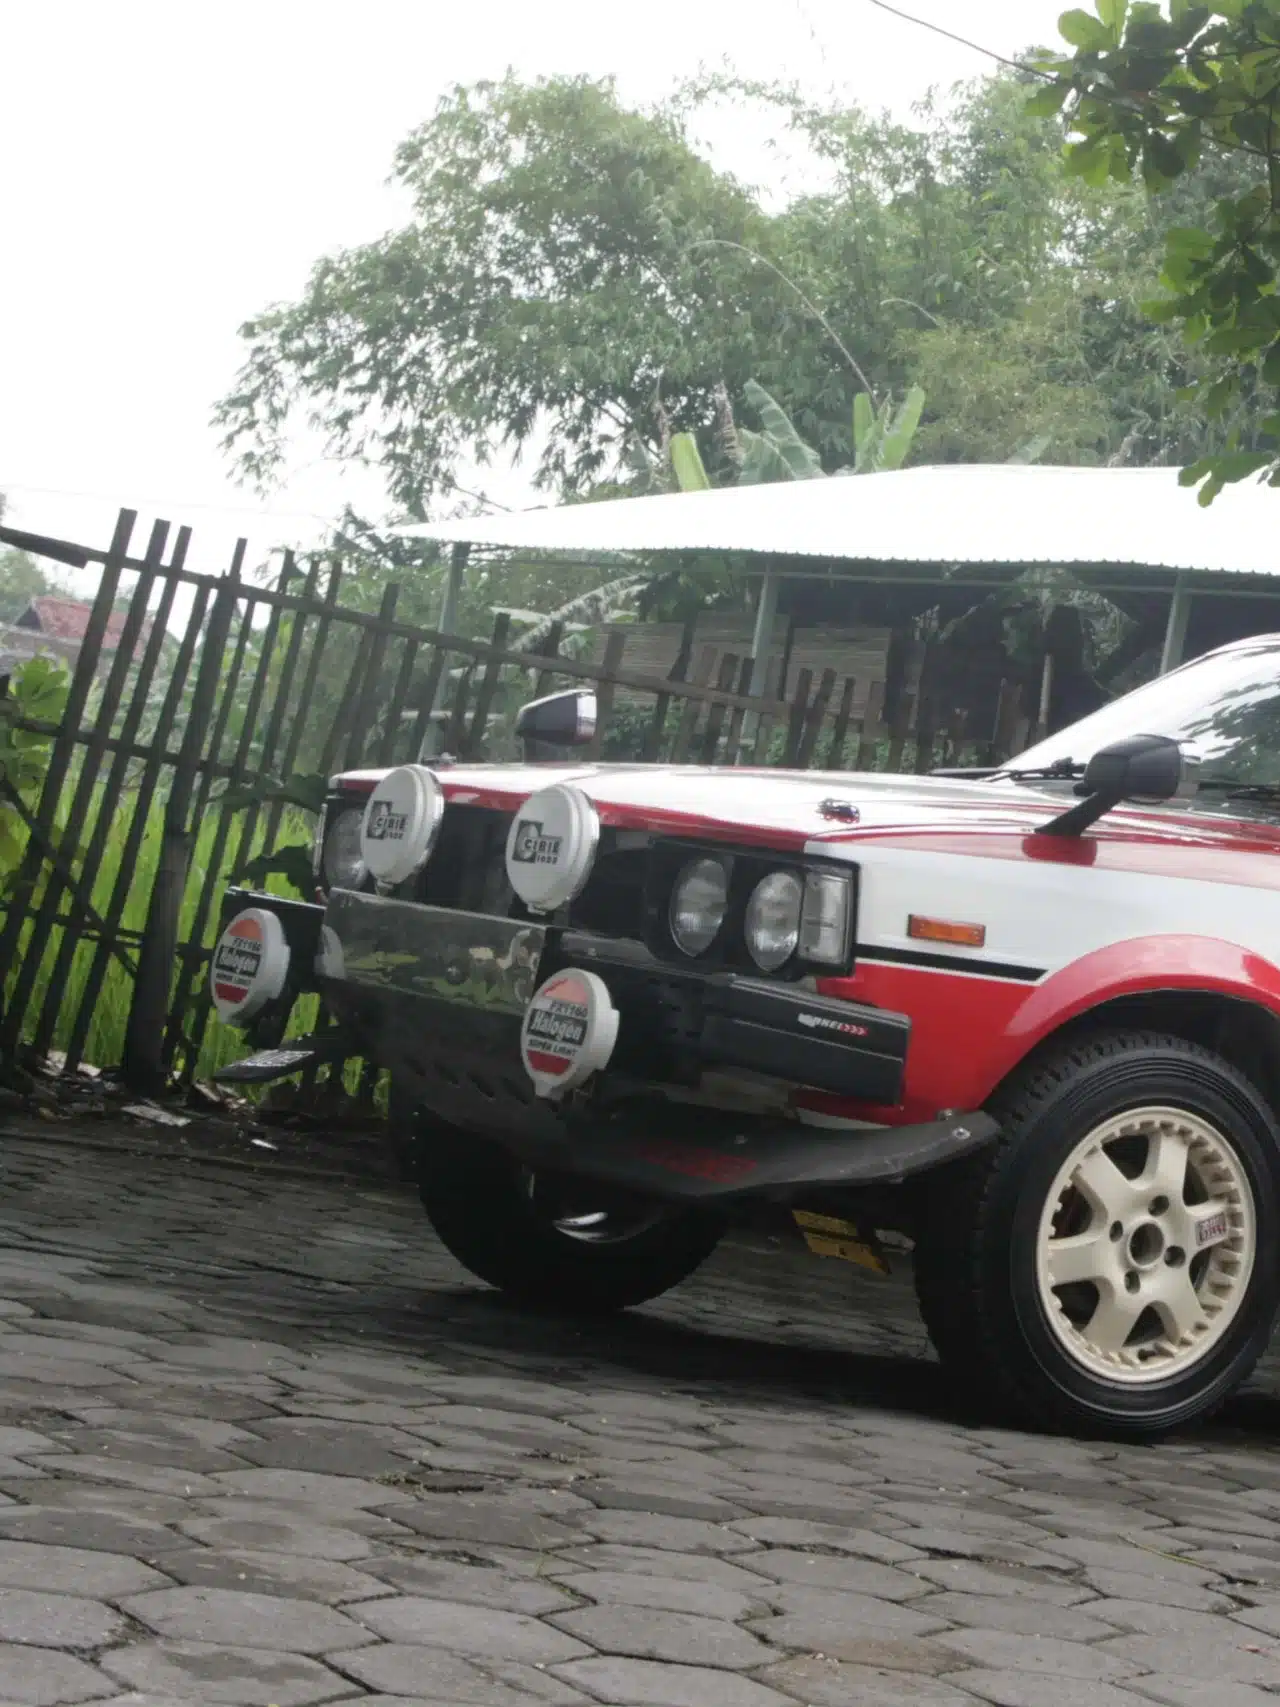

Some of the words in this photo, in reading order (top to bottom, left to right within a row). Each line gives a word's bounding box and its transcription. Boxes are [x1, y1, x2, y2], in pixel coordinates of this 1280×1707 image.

[531, 1010, 583, 1041] Halogen
[528, 1039, 552, 1051] SUPER
[553, 1044, 577, 1056] LIGHT
